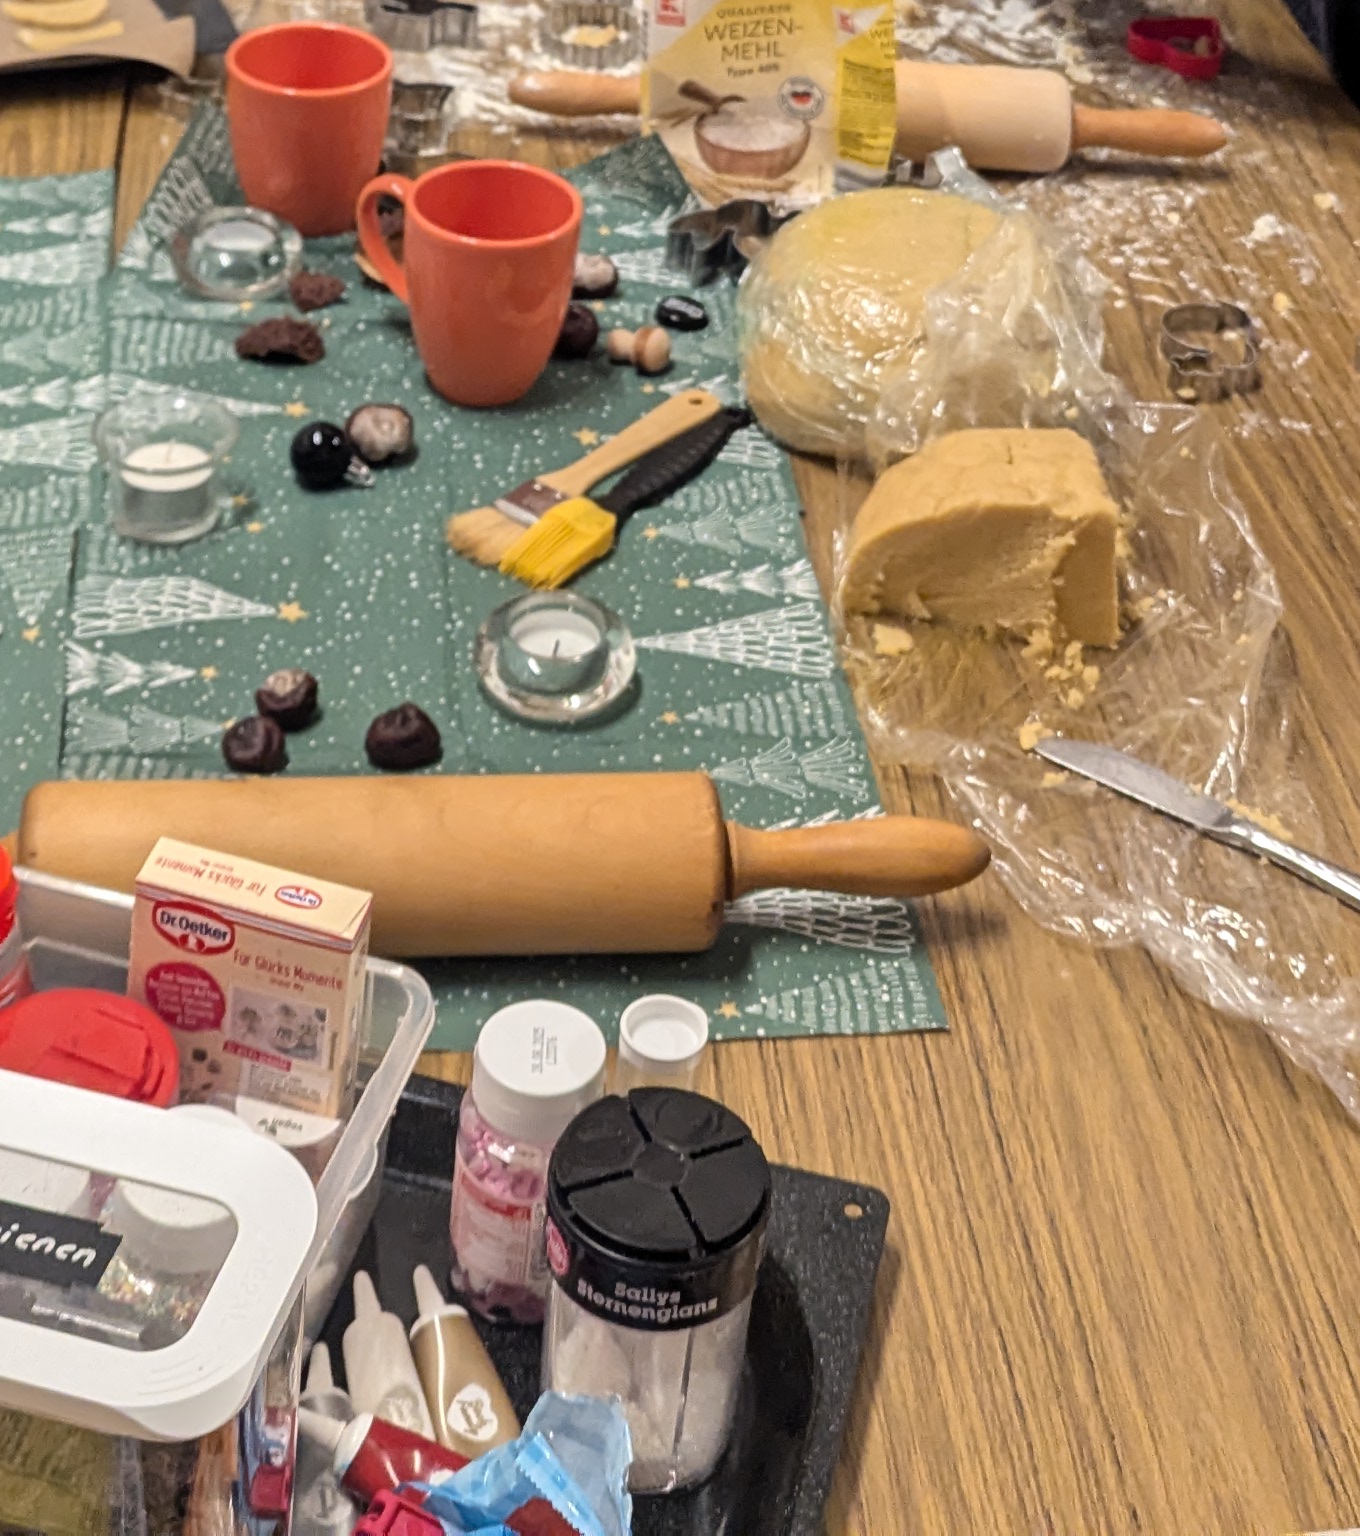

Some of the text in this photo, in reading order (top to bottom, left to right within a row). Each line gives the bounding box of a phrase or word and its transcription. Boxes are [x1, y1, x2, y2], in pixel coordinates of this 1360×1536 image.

[704, 18, 804, 42] WEIZEN-
[721, 41, 785, 63] MEHL
[614, 1281, 681, 1306] Sallys
